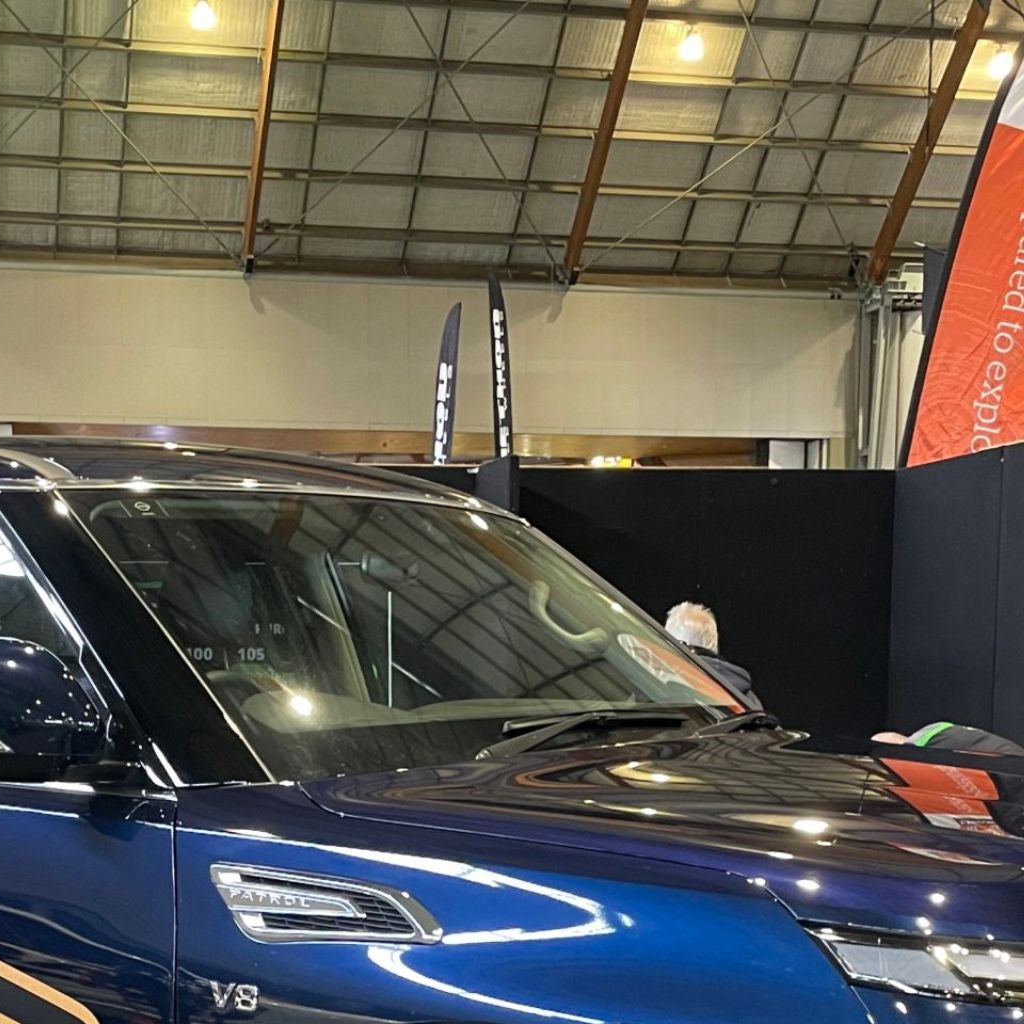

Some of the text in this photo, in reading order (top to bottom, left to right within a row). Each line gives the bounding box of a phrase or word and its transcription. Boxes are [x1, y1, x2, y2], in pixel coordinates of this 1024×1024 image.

[993, 321, 1022, 353] to
[238, 647, 265, 660] 105
[229, 888, 311, 908] PATROL
[209, 980, 260, 1012] V8
